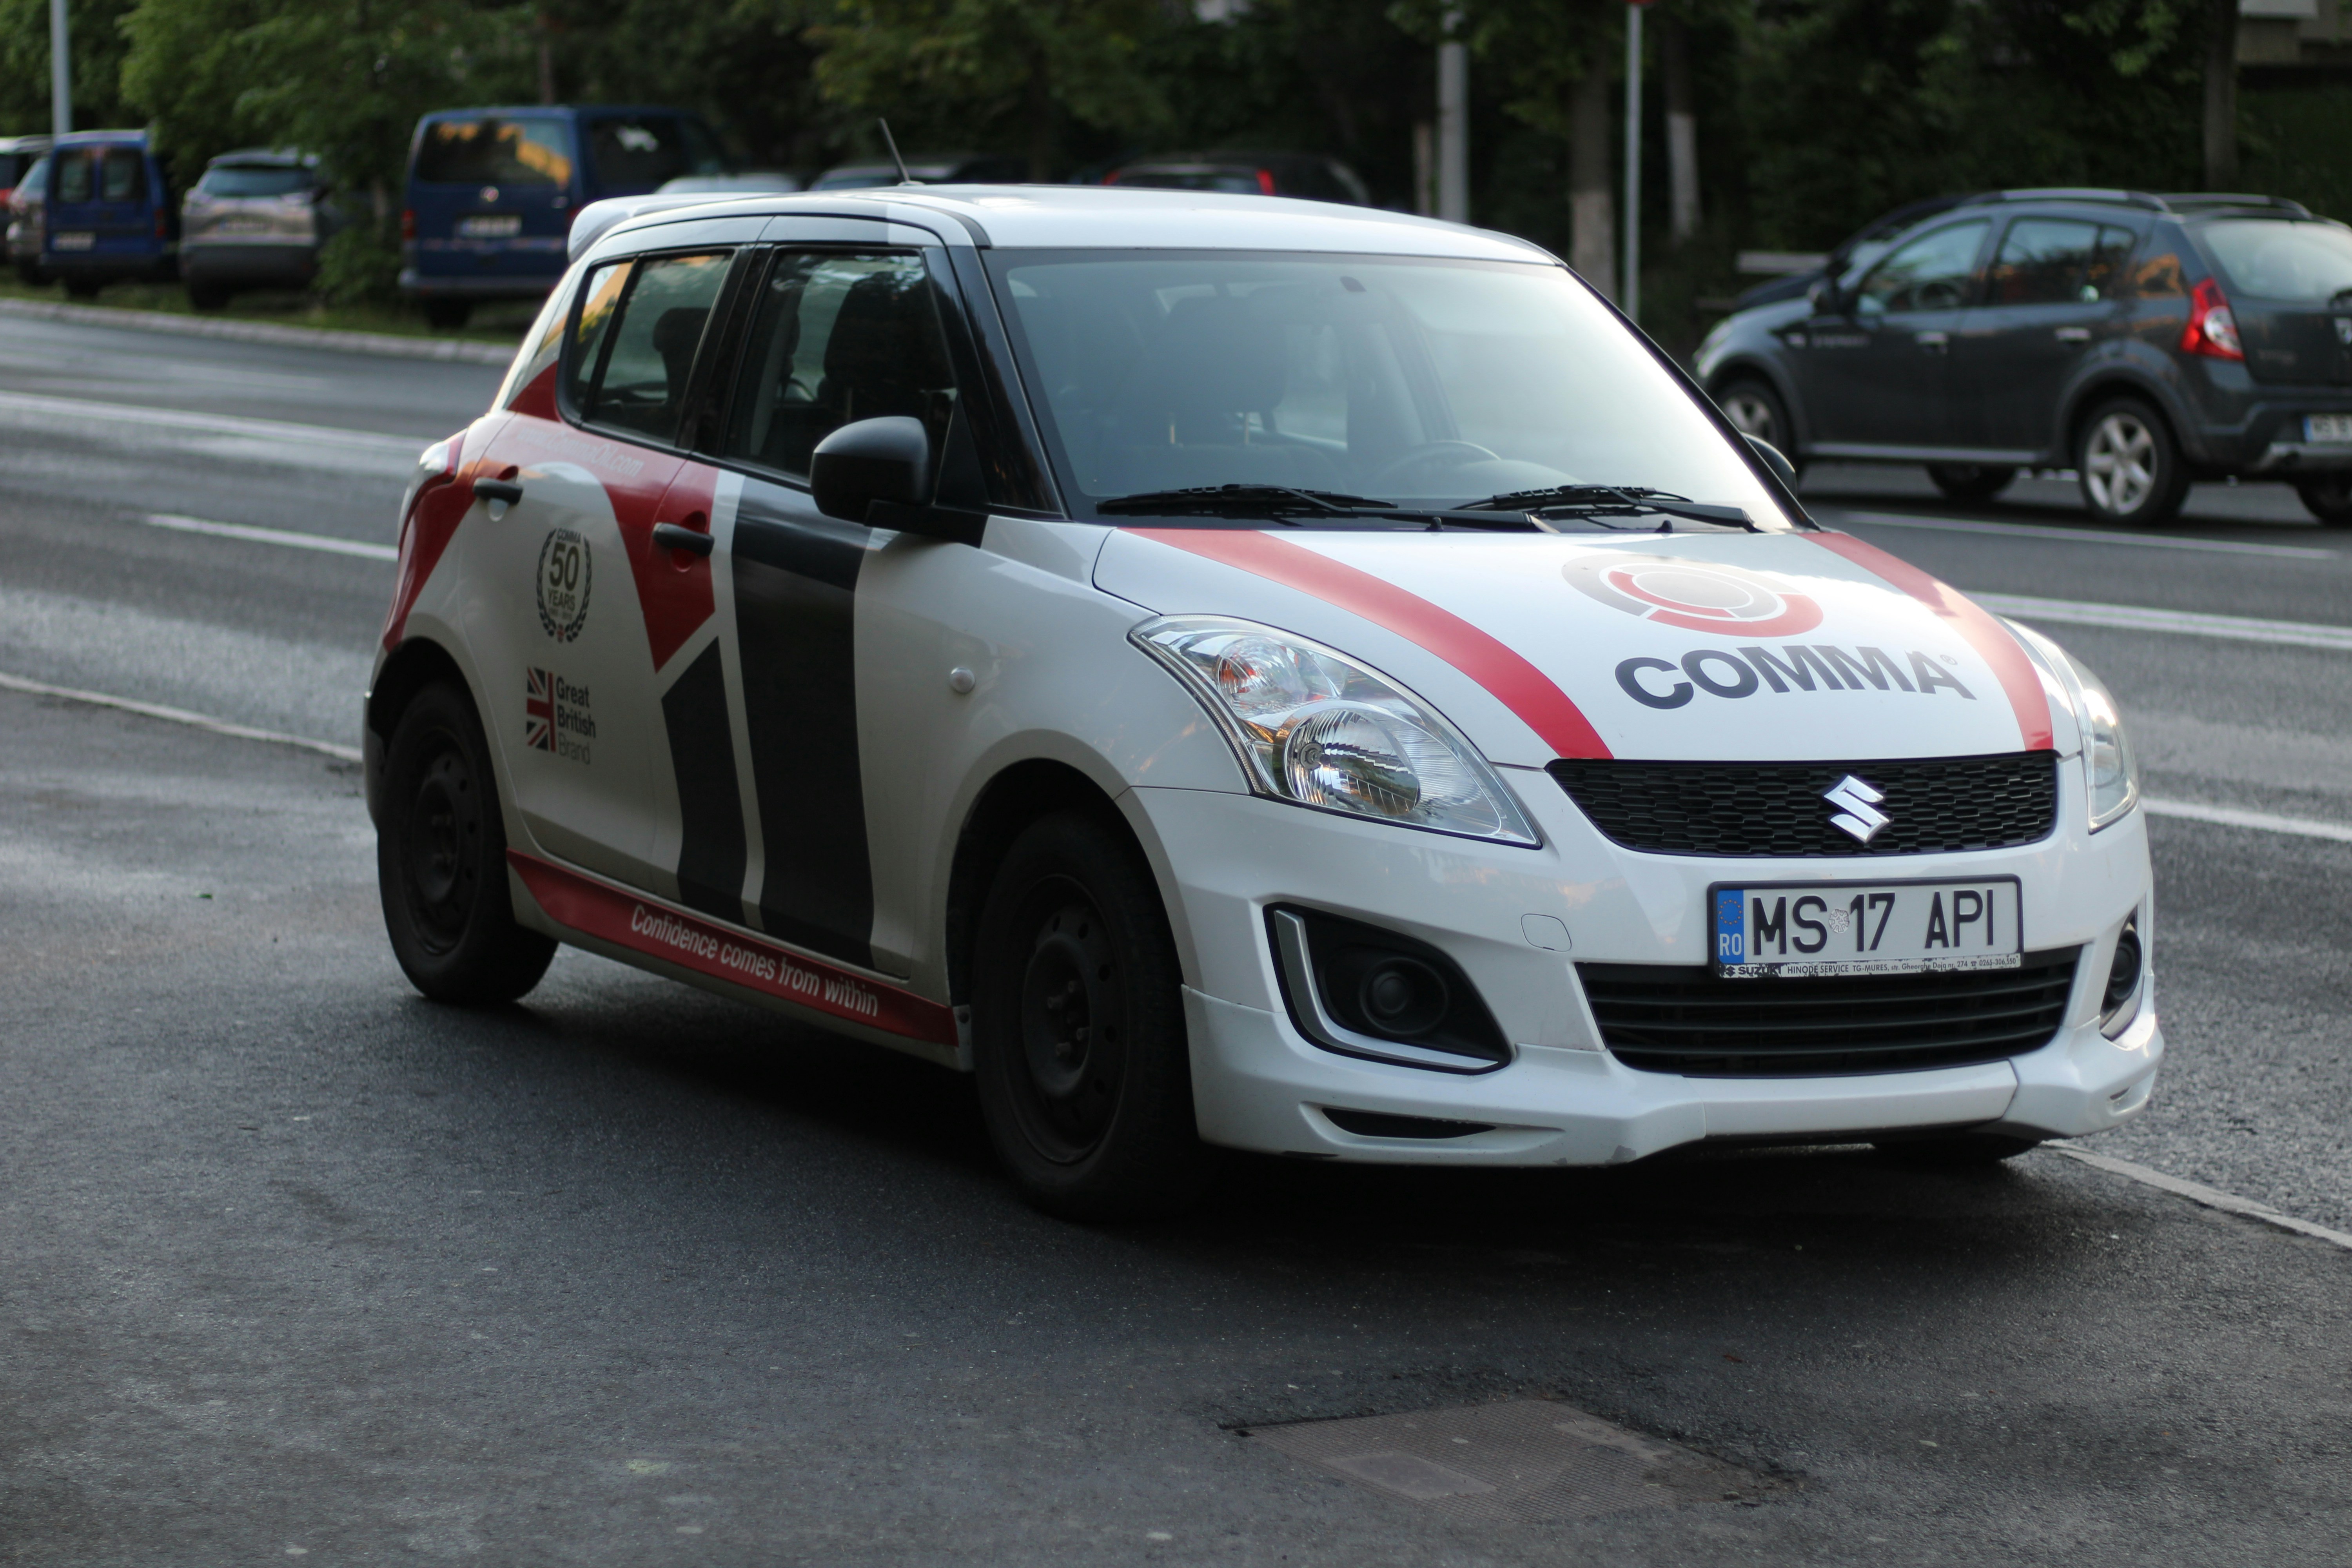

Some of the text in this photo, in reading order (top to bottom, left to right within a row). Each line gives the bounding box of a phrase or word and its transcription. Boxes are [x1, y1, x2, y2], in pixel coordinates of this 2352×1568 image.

[549, 542, 579, 591] 50
[548, 588, 576, 612] YEARS
[556, 676, 590, 707] Great
[557, 705, 596, 737] British
[558, 732, 590, 765] Brand
[1752, 889, 1994, 956] MS 17 API
[632, 904, 879, 1017] Confidence comes from within
[1719, 933, 1742, 956] RO
[1788, 965, 1818, 974] HINODE
[1820, 964, 1849, 973] SERVICE
[1902, 962, 1931, 971] Gheorghe
